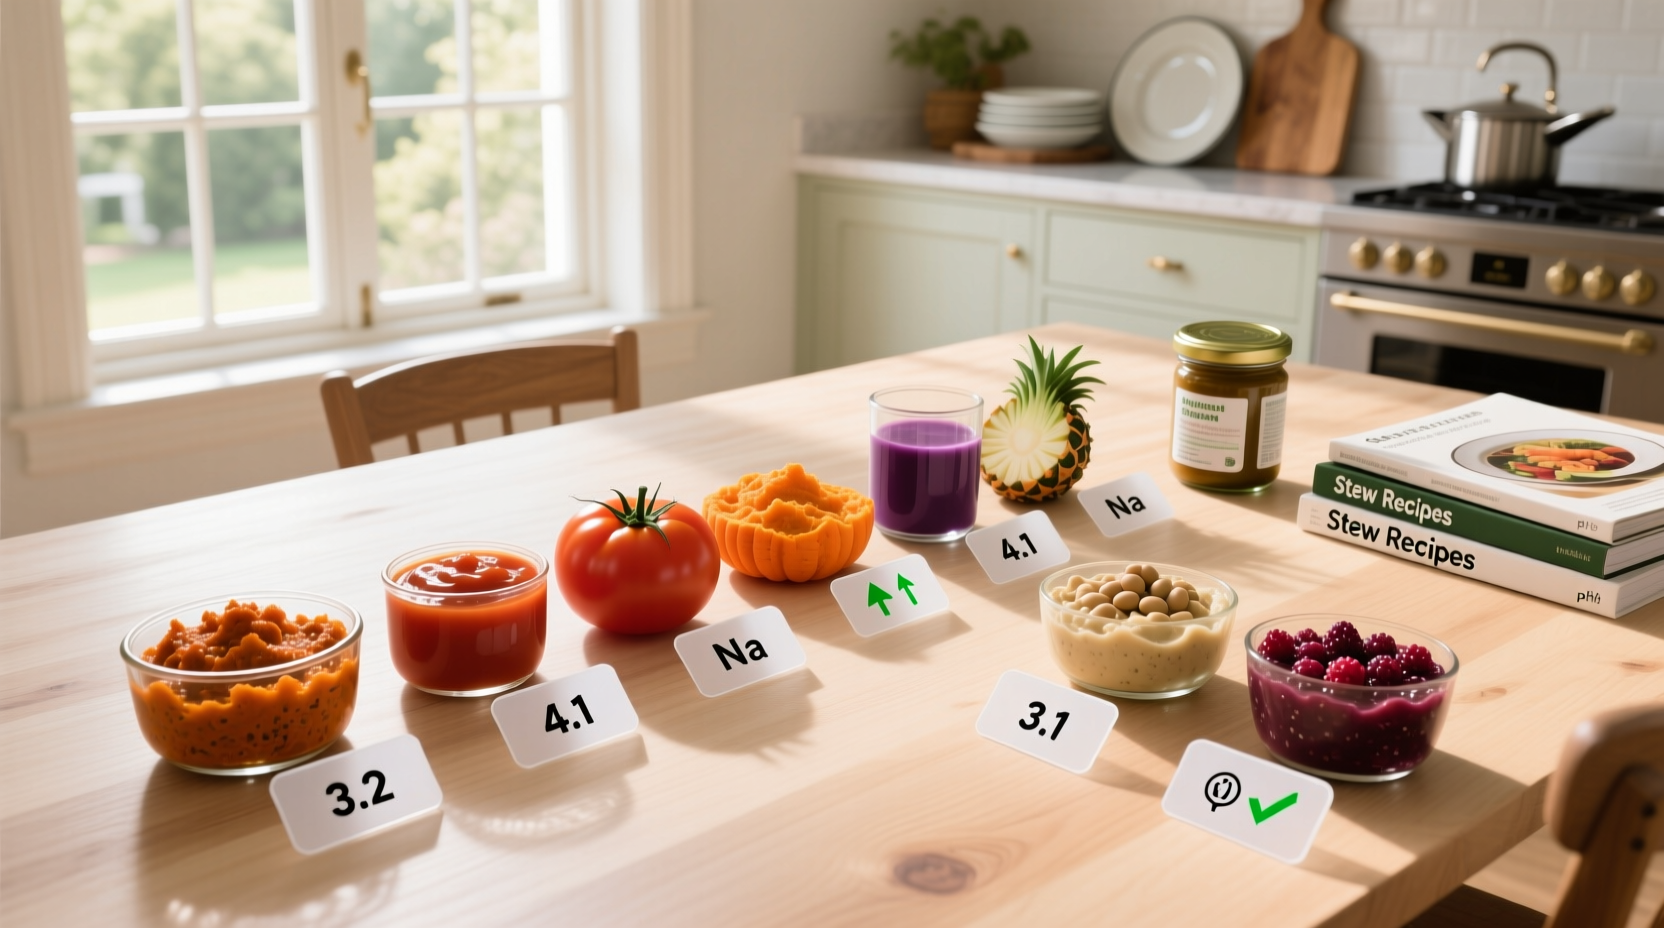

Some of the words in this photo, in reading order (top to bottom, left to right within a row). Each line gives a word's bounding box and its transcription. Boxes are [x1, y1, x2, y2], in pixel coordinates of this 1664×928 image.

[1104, 495, 1146, 520] Na
[1333, 475, 1378, 502] Stew
[1381, 488, 1453, 526] Recipes
[1001, 532, 1038, 561] 4.1
[1326, 509, 1380, 544] Stew
[1385, 526, 1476, 571] Recipes
[711, 636, 769, 672] Na
[544, 694, 595, 735] 4.1
[1018, 700, 1071, 742] 3.1
[324, 769, 395, 817] 3.2
